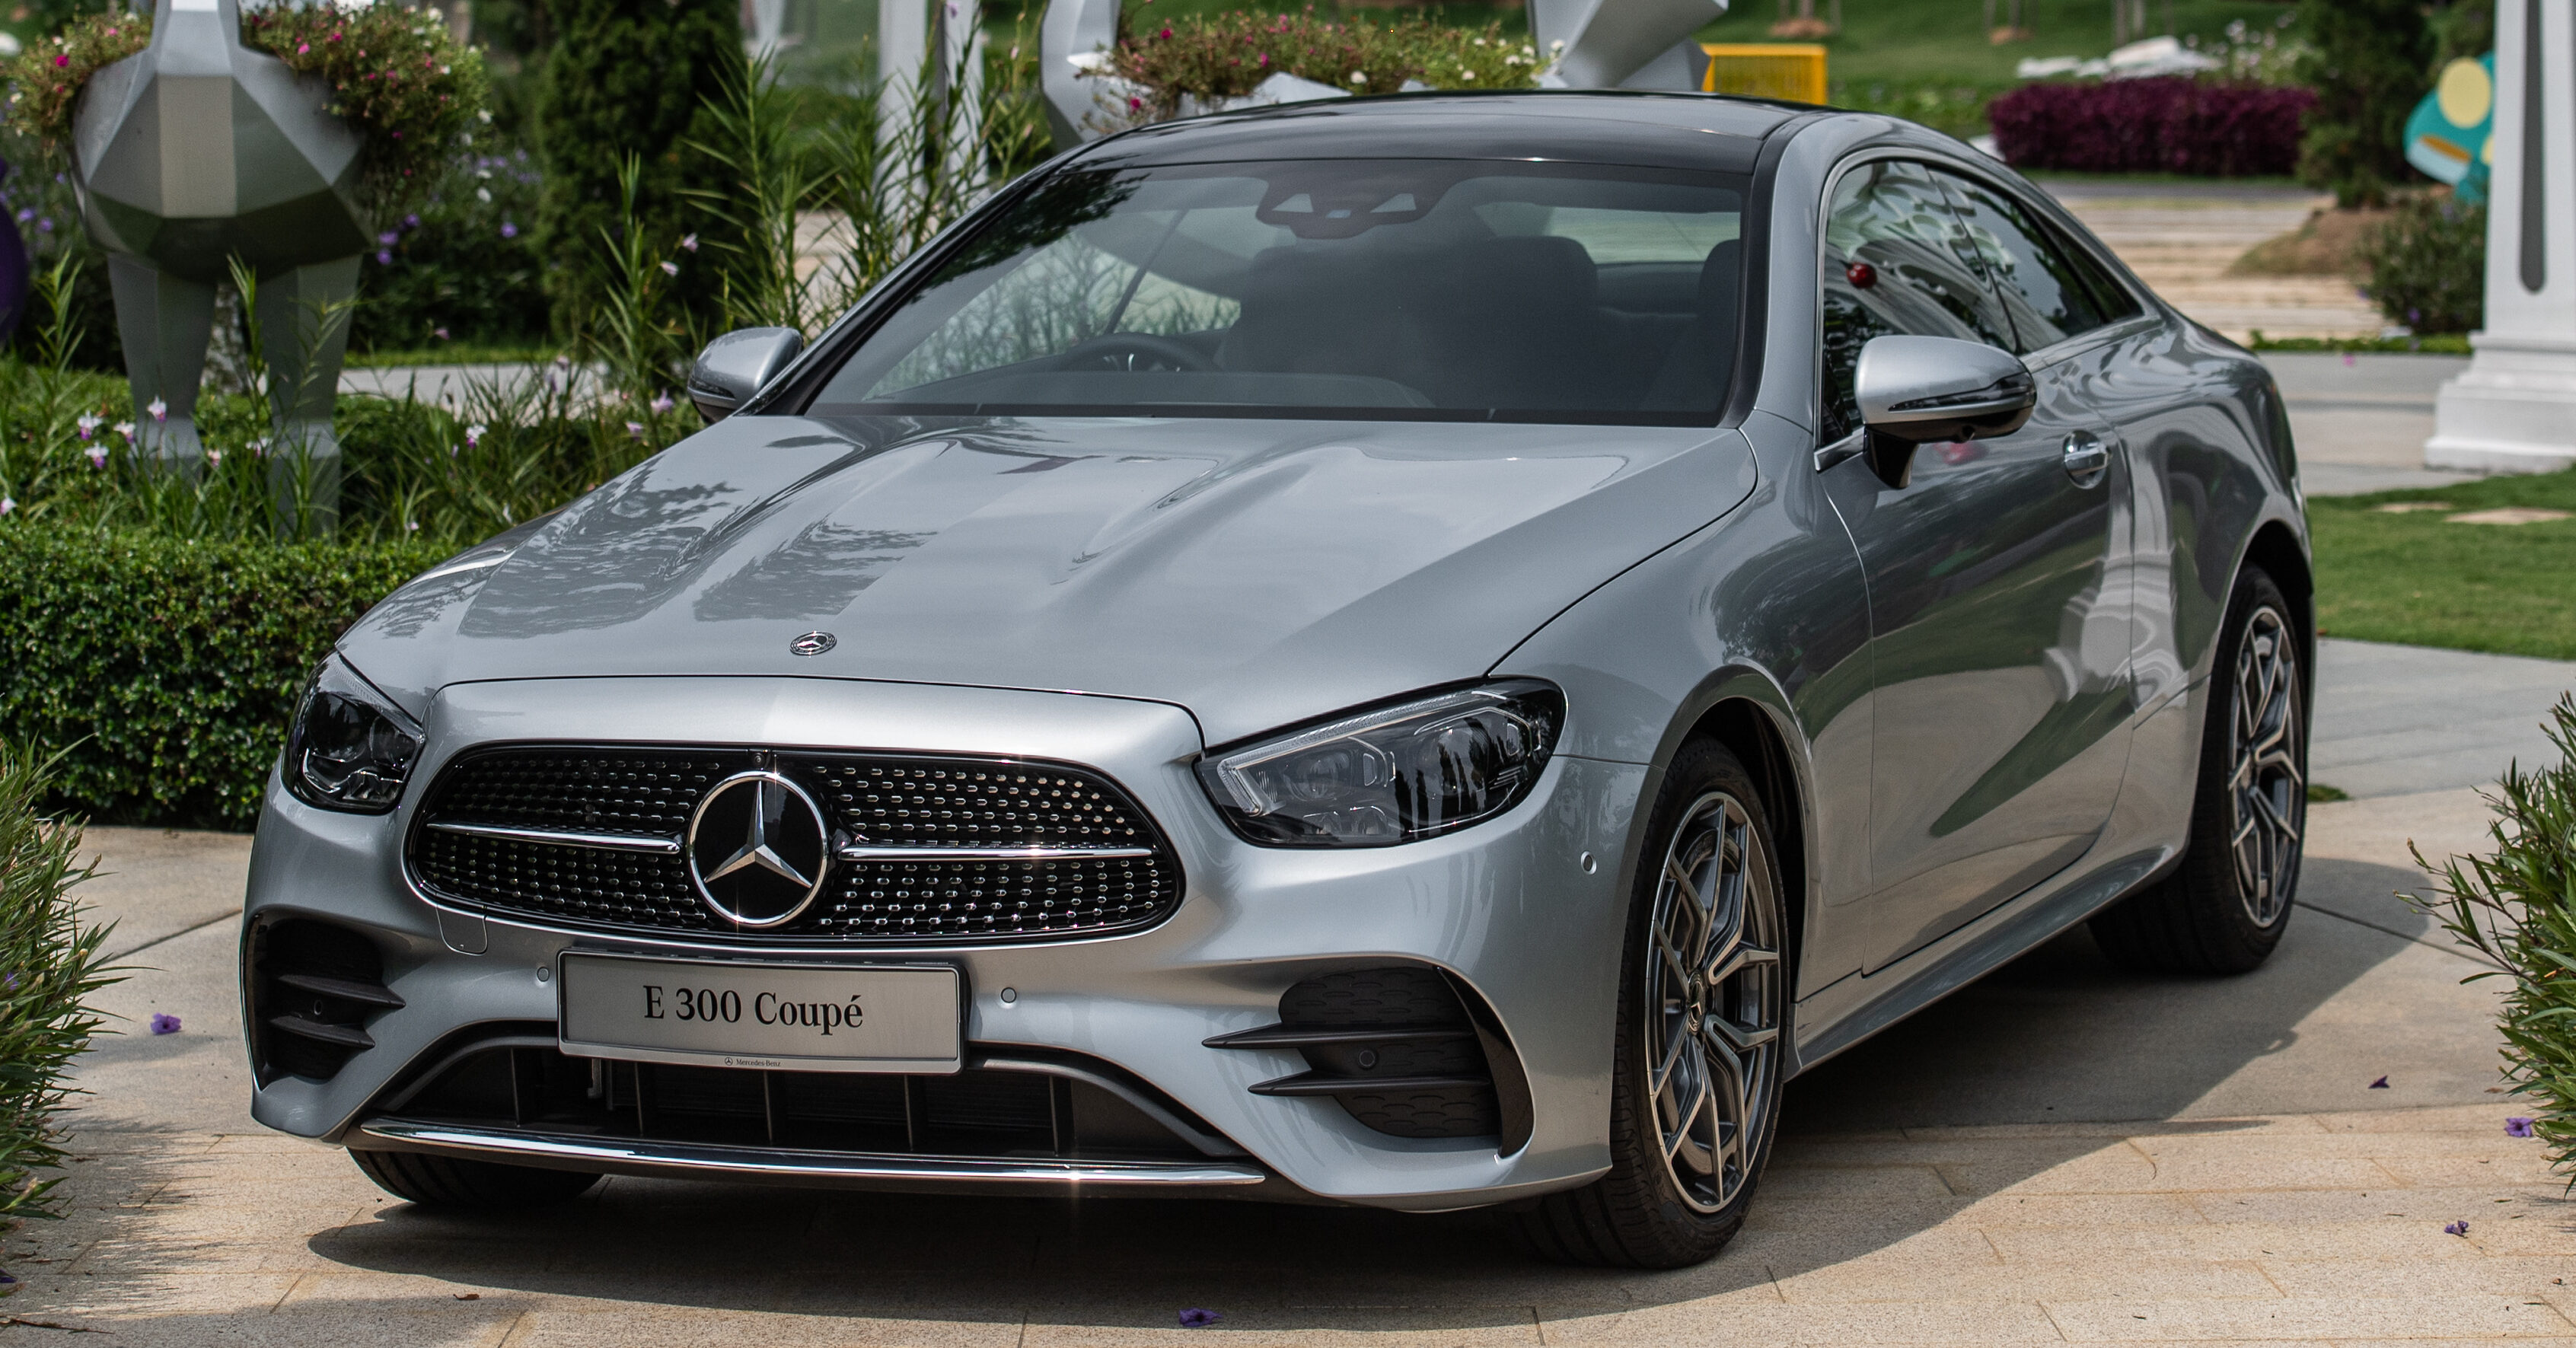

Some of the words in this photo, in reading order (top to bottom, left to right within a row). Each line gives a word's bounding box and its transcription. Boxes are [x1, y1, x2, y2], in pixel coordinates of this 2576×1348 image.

[642, 985, 665, 1019] E
[675, 987, 742, 1023] 300
[754, 992, 863, 1036] Coupé
[735, 1058, 781, 1067] Mercedes-Benz
